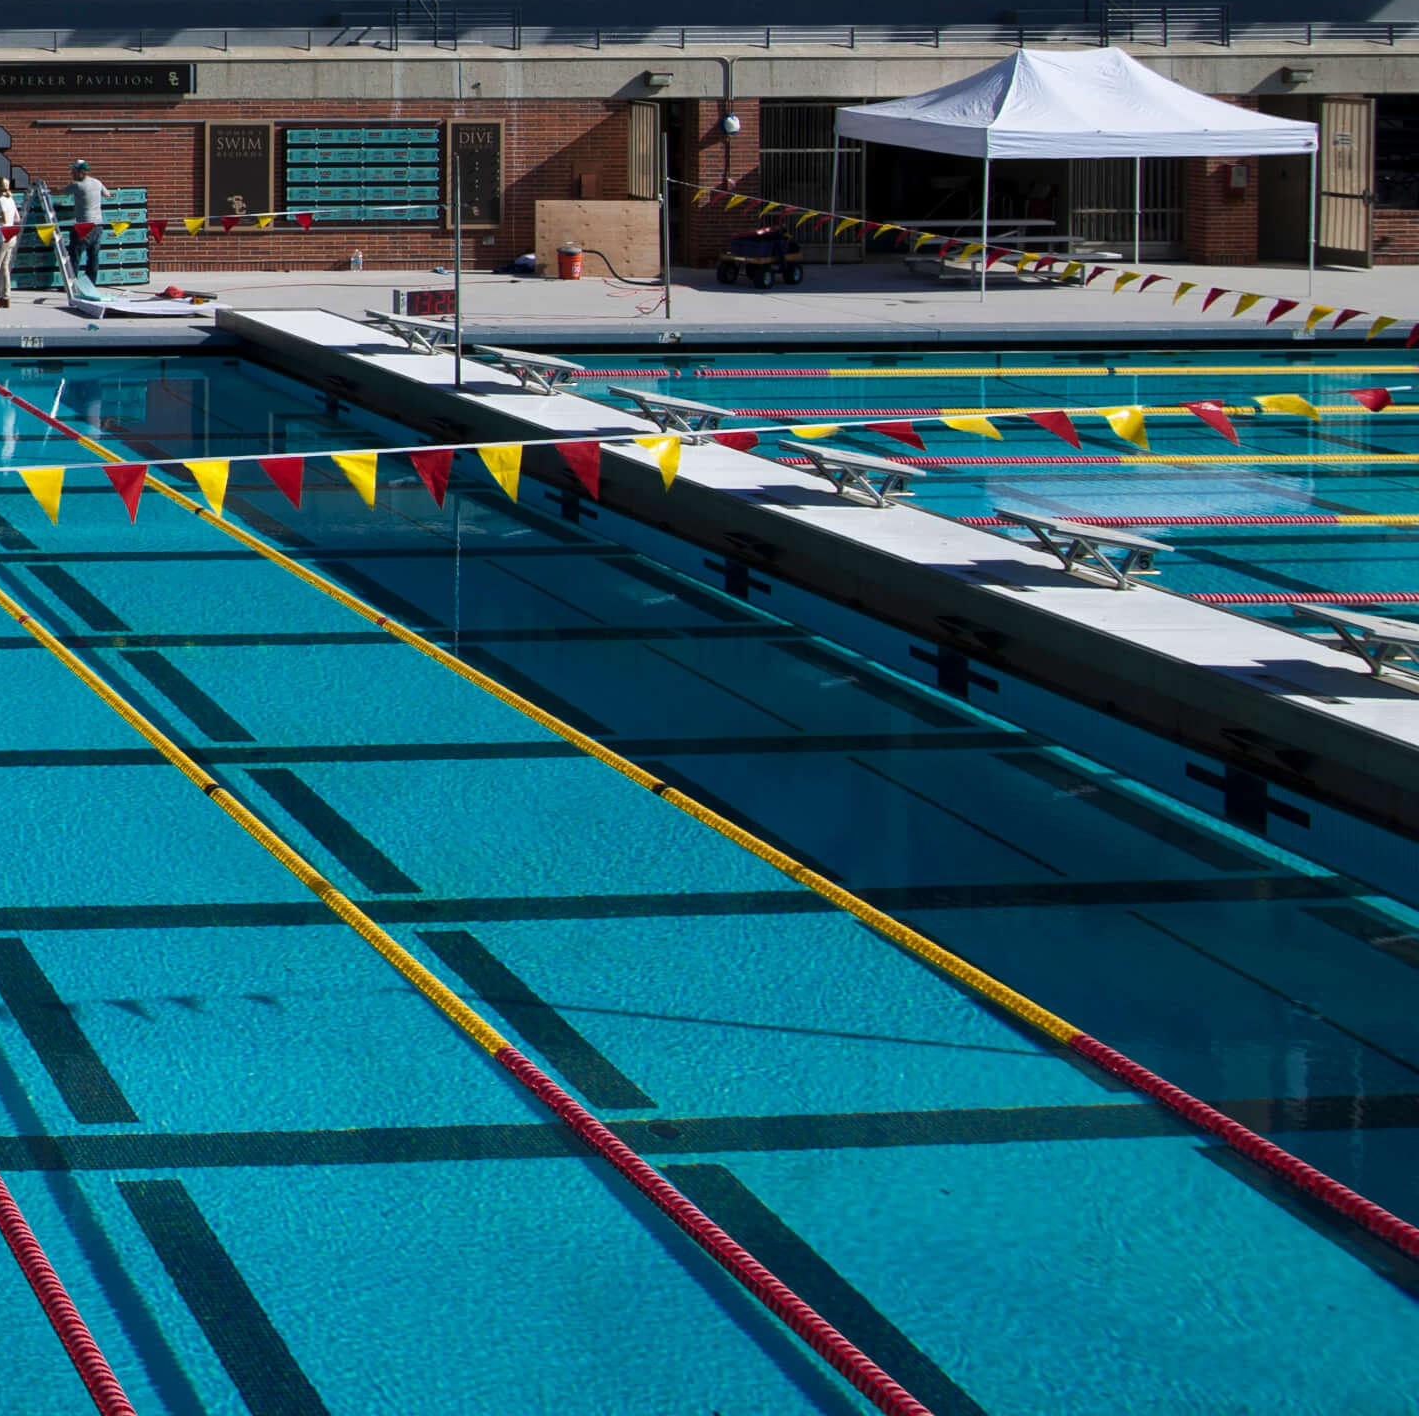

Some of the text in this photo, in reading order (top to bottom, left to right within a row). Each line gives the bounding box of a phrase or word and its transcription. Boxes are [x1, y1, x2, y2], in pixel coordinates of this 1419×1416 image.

[0, 74, 68, 88] SPIEKER
[76, 73, 155, 87] PAVILION
[216, 136, 262, 150] SWIM
[1138, 553, 1150, 570] 5
